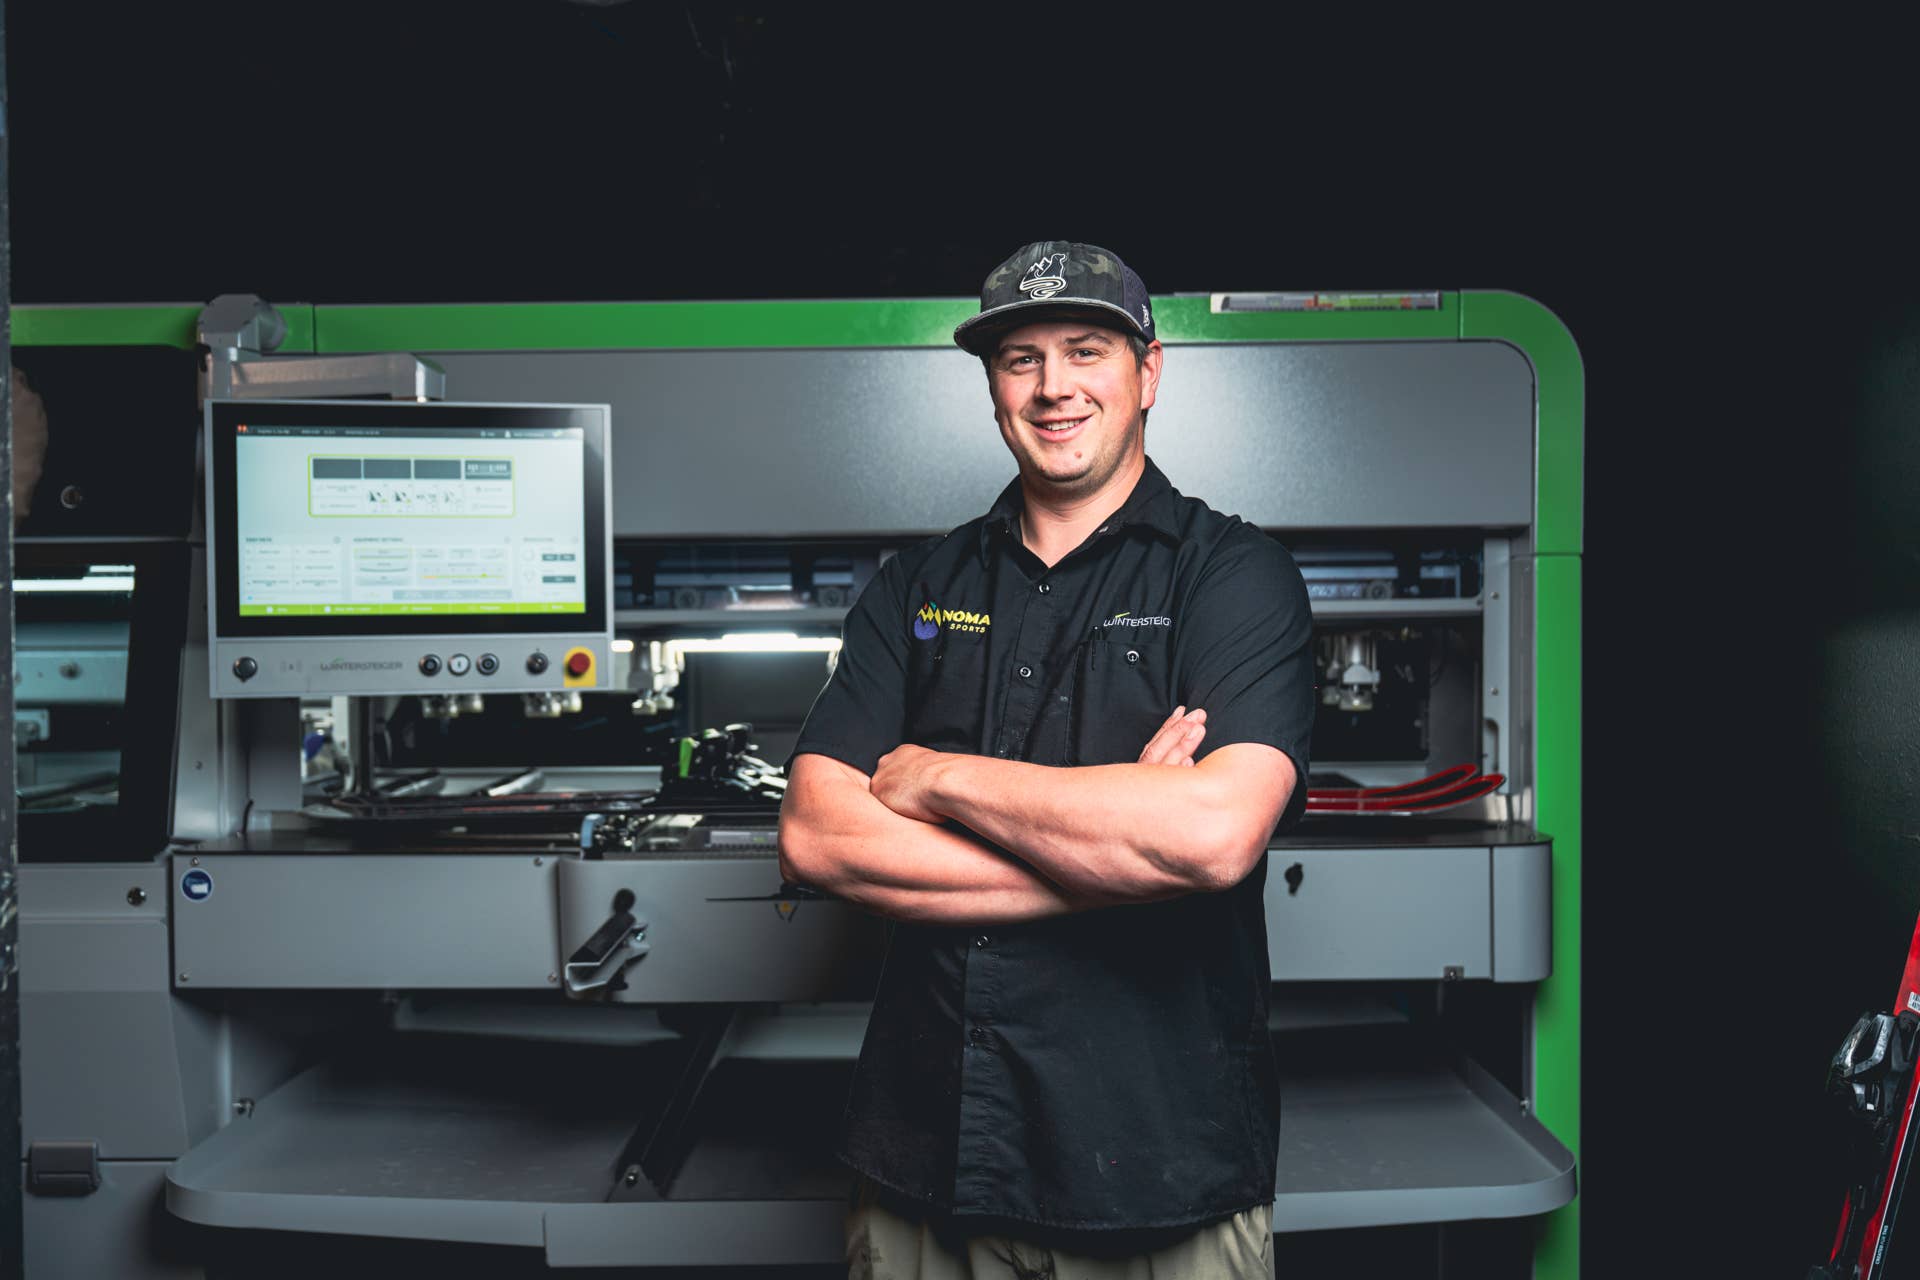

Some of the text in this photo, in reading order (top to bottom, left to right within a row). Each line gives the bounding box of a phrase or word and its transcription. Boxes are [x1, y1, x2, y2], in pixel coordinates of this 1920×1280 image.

[943, 609, 990, 625] NOMA
[949, 623, 986, 633] SPORTS
[320, 660, 403, 671] WINTERSTEIGER
